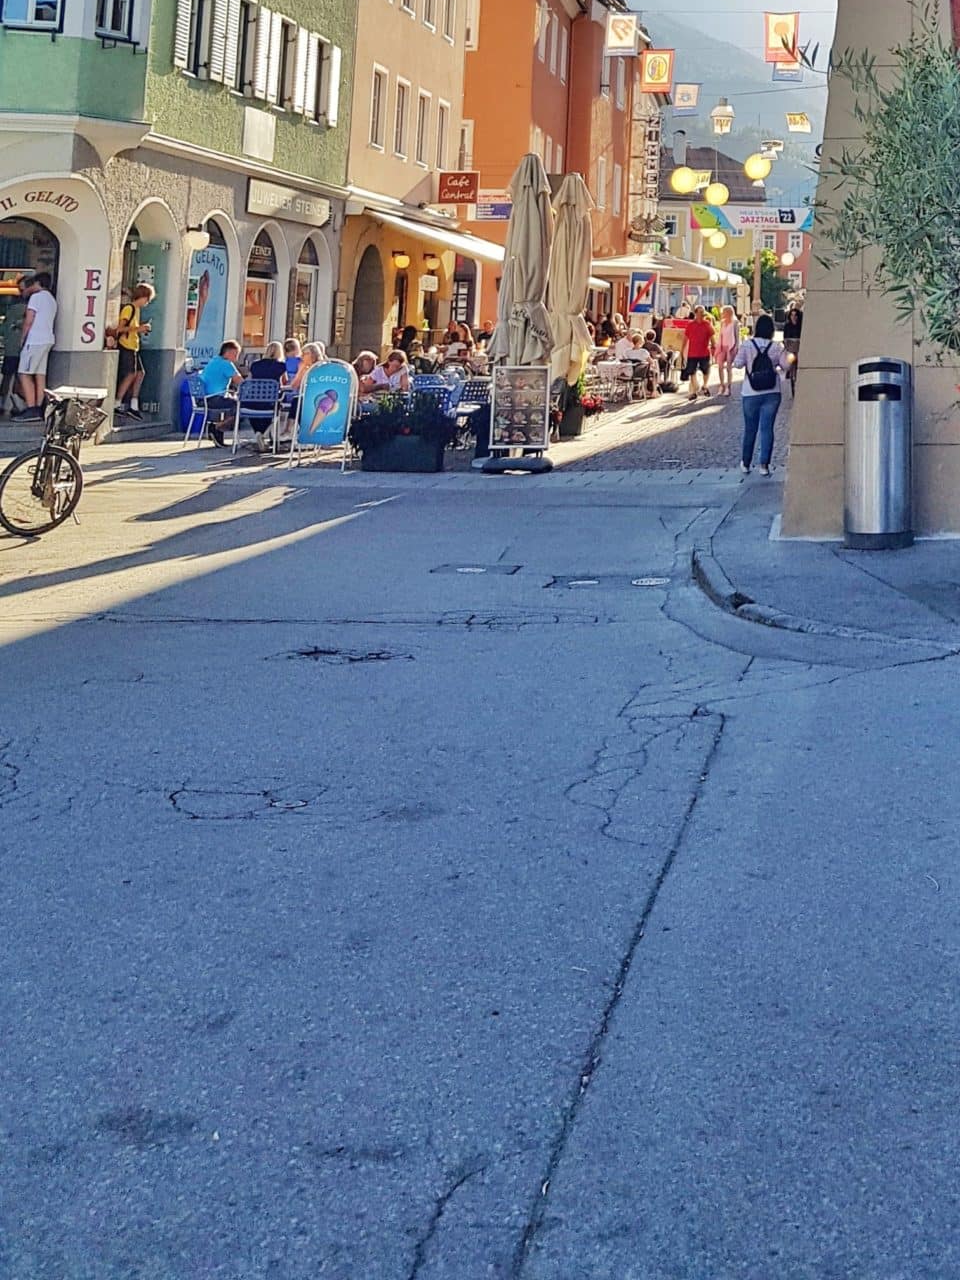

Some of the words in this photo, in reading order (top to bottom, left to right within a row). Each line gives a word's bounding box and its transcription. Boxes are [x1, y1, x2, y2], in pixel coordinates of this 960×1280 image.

[647, 119, 660, 199] ZIMMER
[0, 197, 17, 211] IL
[24, 191, 80, 213] GELATO
[253, 187, 293, 211] JUWELIER
[295, 200, 327, 219] STEINER
[196, 250, 225, 277] GELATO
[81, 270, 102, 344] EIS
[319, 375, 348, 385] GELATO
